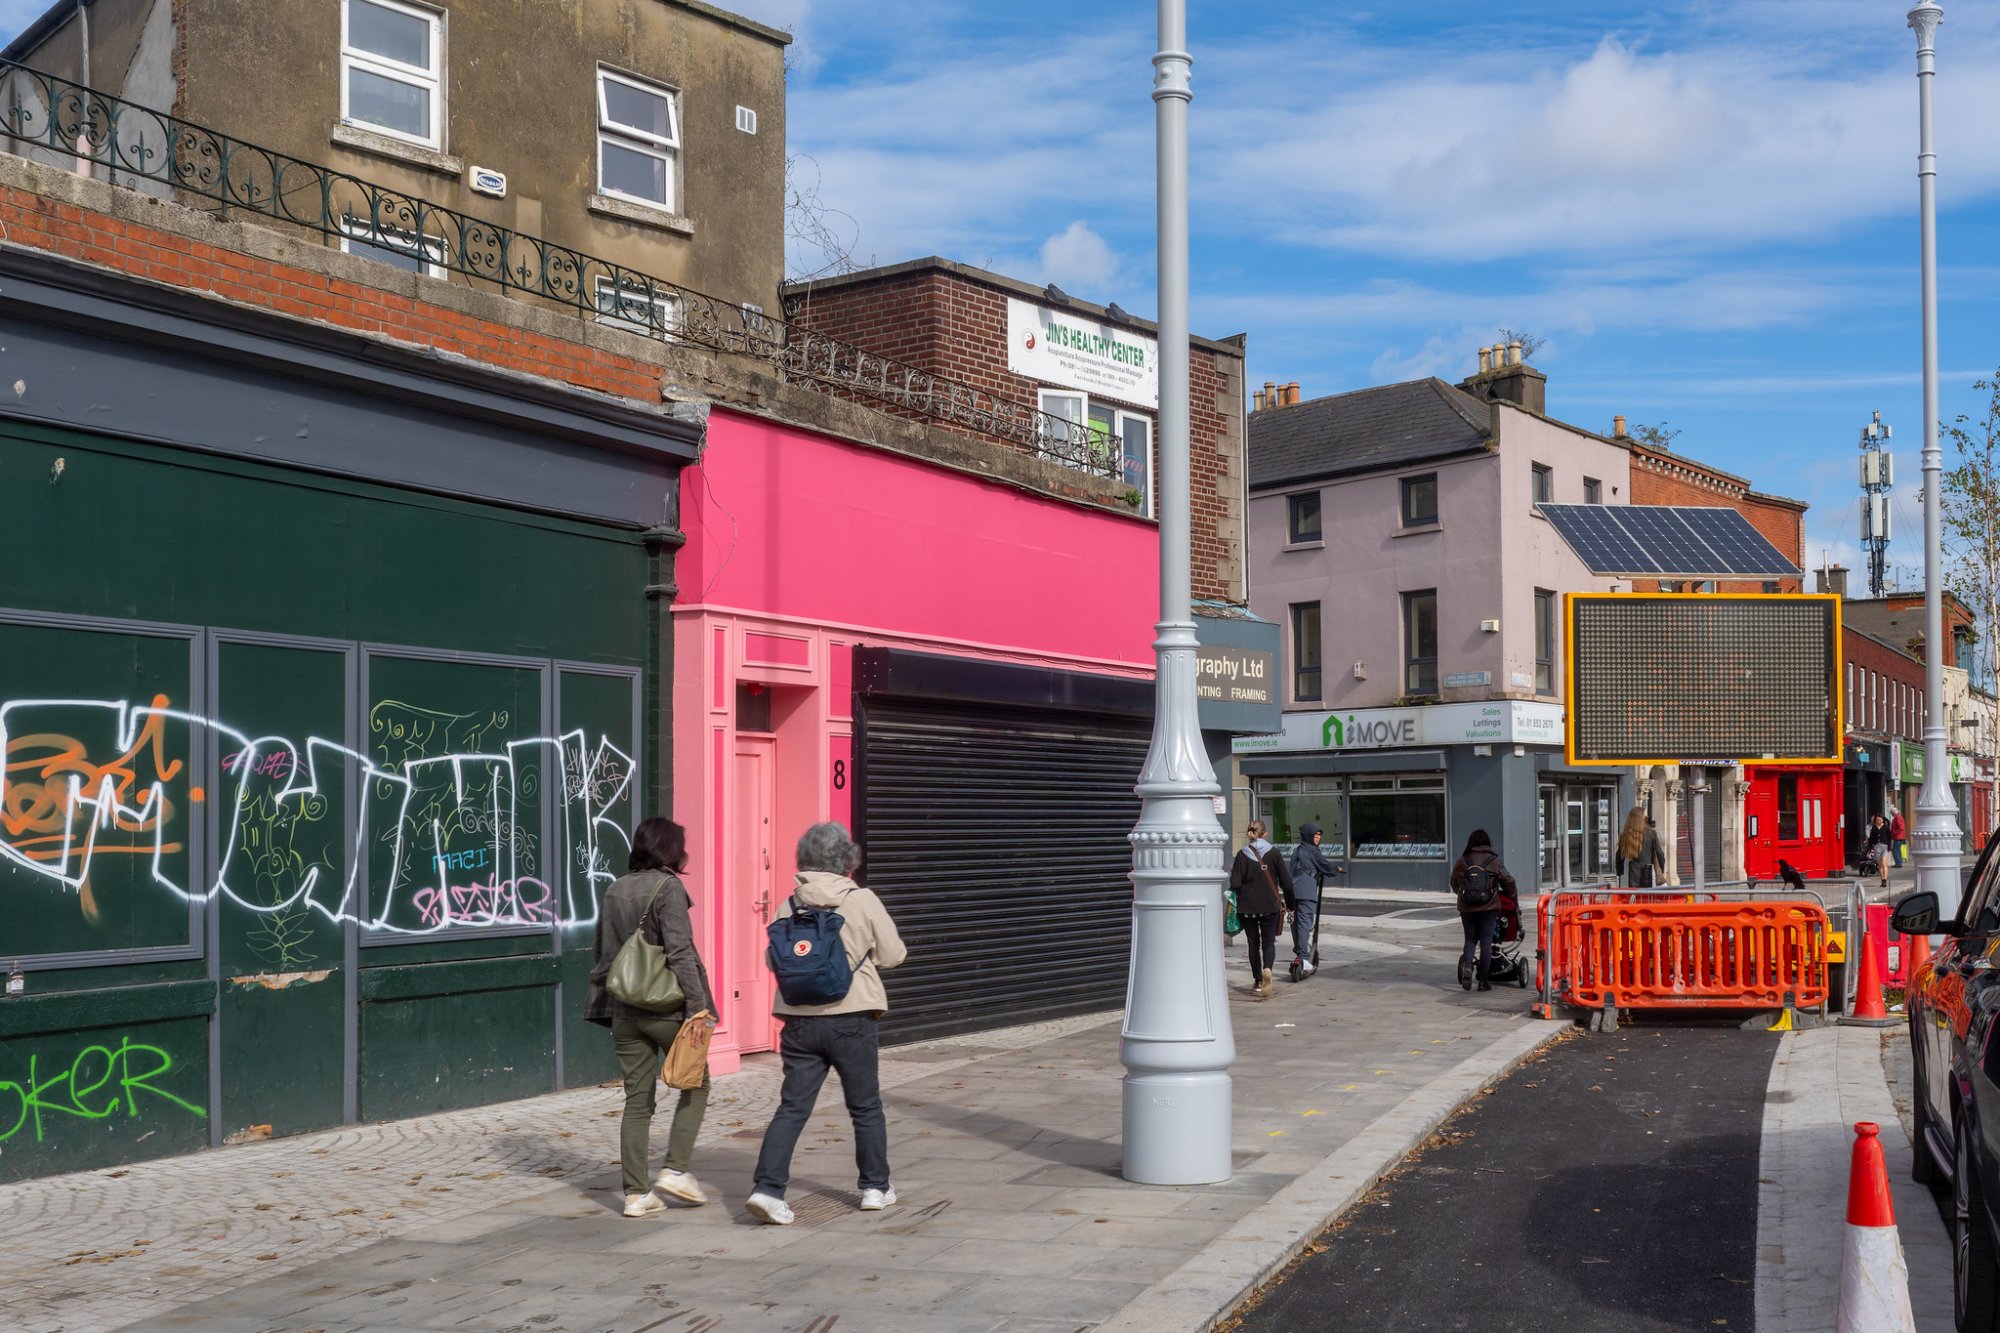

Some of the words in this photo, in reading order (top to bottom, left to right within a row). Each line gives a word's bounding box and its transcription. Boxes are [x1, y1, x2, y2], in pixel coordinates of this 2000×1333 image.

[1046, 322, 1069, 347] JIN'S
[1070, 328, 1110, 358] HEALTHY
[1111, 340, 1145, 368] CENTER
[1075, 353, 1101, 367] Acupressure
[1101, 360, 1125, 374] Professional
[1126, 367, 1143, 379] Massage
[1242, 657, 1264, 678] Ltd
[1231, 687, 1267, 701] FRAMING
[1481, 707, 1501, 716] Sales
[1626, 700, 1777, 738] ROADS
[1466, 729, 1502, 738] Valuations
[1473, 719, 1501, 728] Lettings
[833, 759, 846, 790] 8
